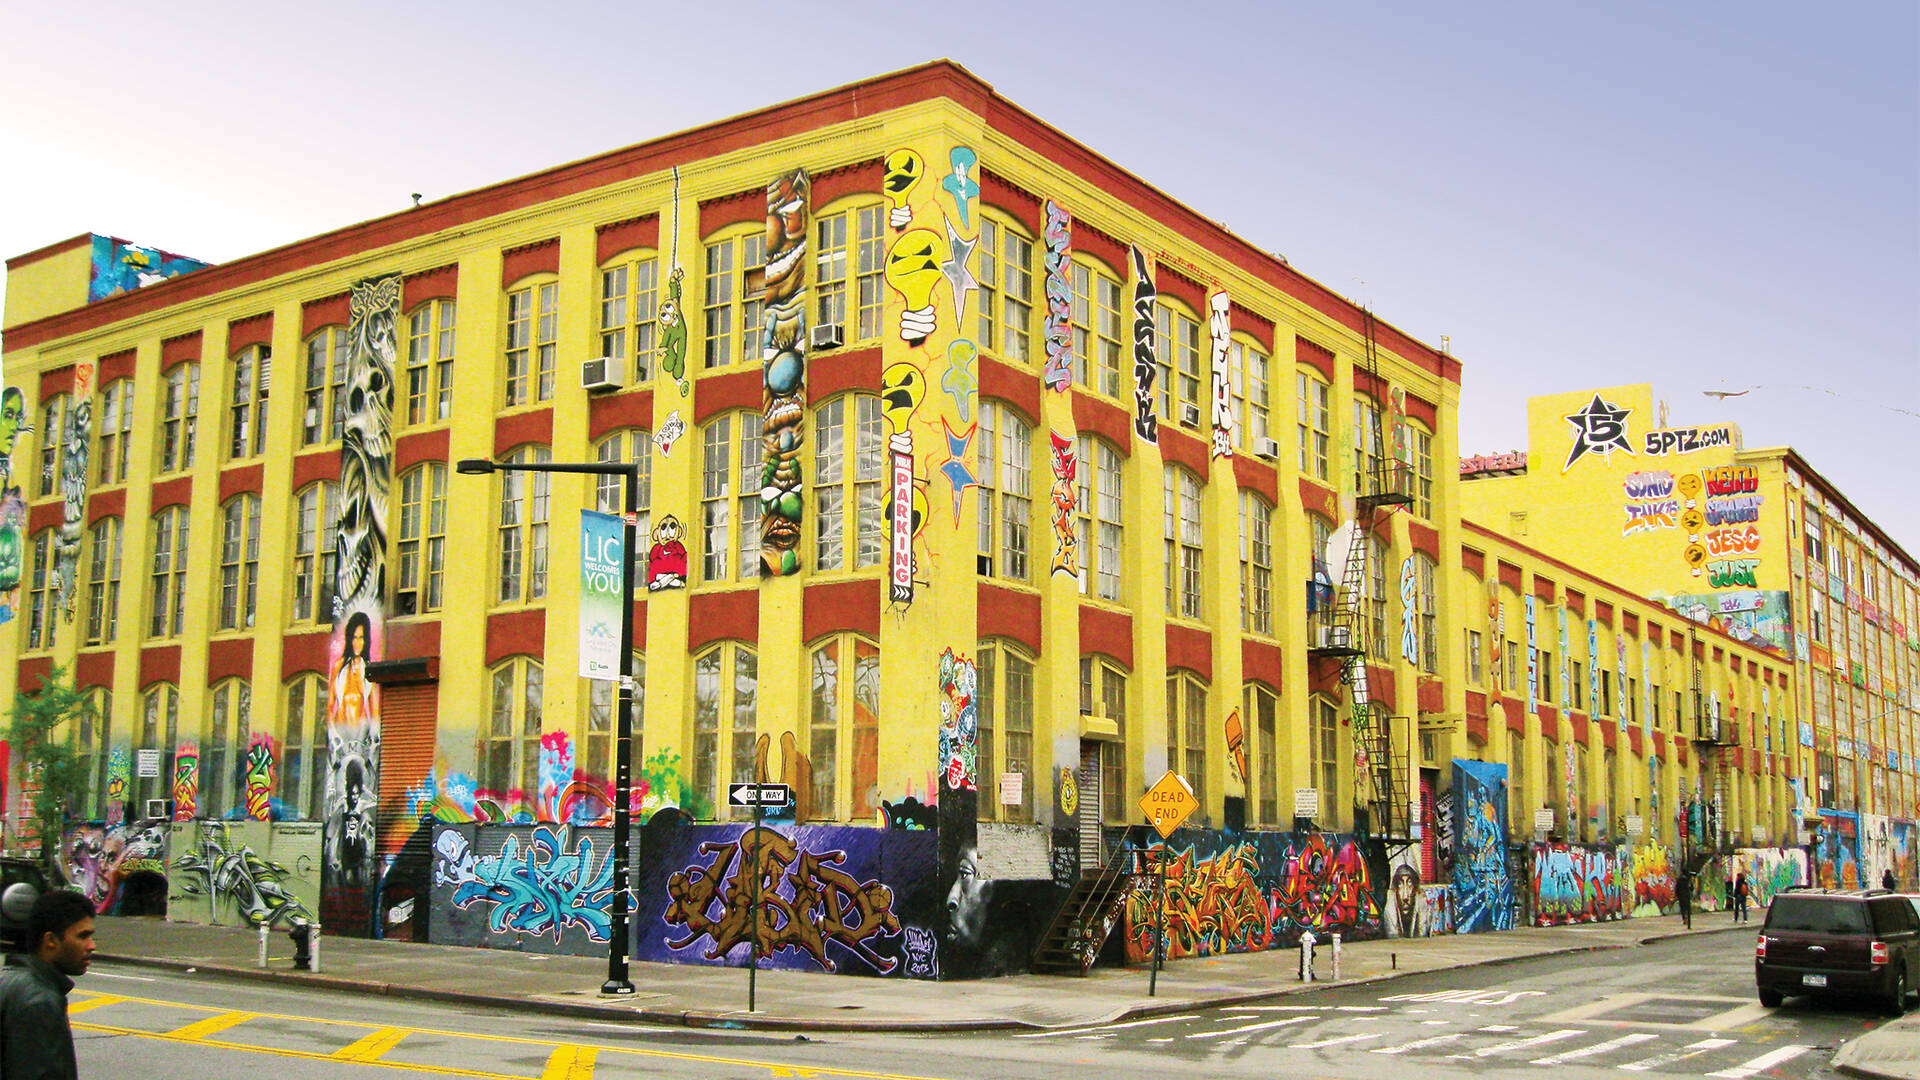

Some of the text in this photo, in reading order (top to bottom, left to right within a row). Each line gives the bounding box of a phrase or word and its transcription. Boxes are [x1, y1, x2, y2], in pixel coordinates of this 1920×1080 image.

[1645, 428, 1731, 455] 5PTZ.COM
[896, 472, 910, 583] PARKING
[584, 533, 620, 566] LIC
[584, 570, 621, 594] YOU
[1707, 559, 1761, 588] JUST
[765, 791, 782, 800] WAY
[1152, 791, 1185, 803] DEAD
[1155, 807, 1179, 819] END
